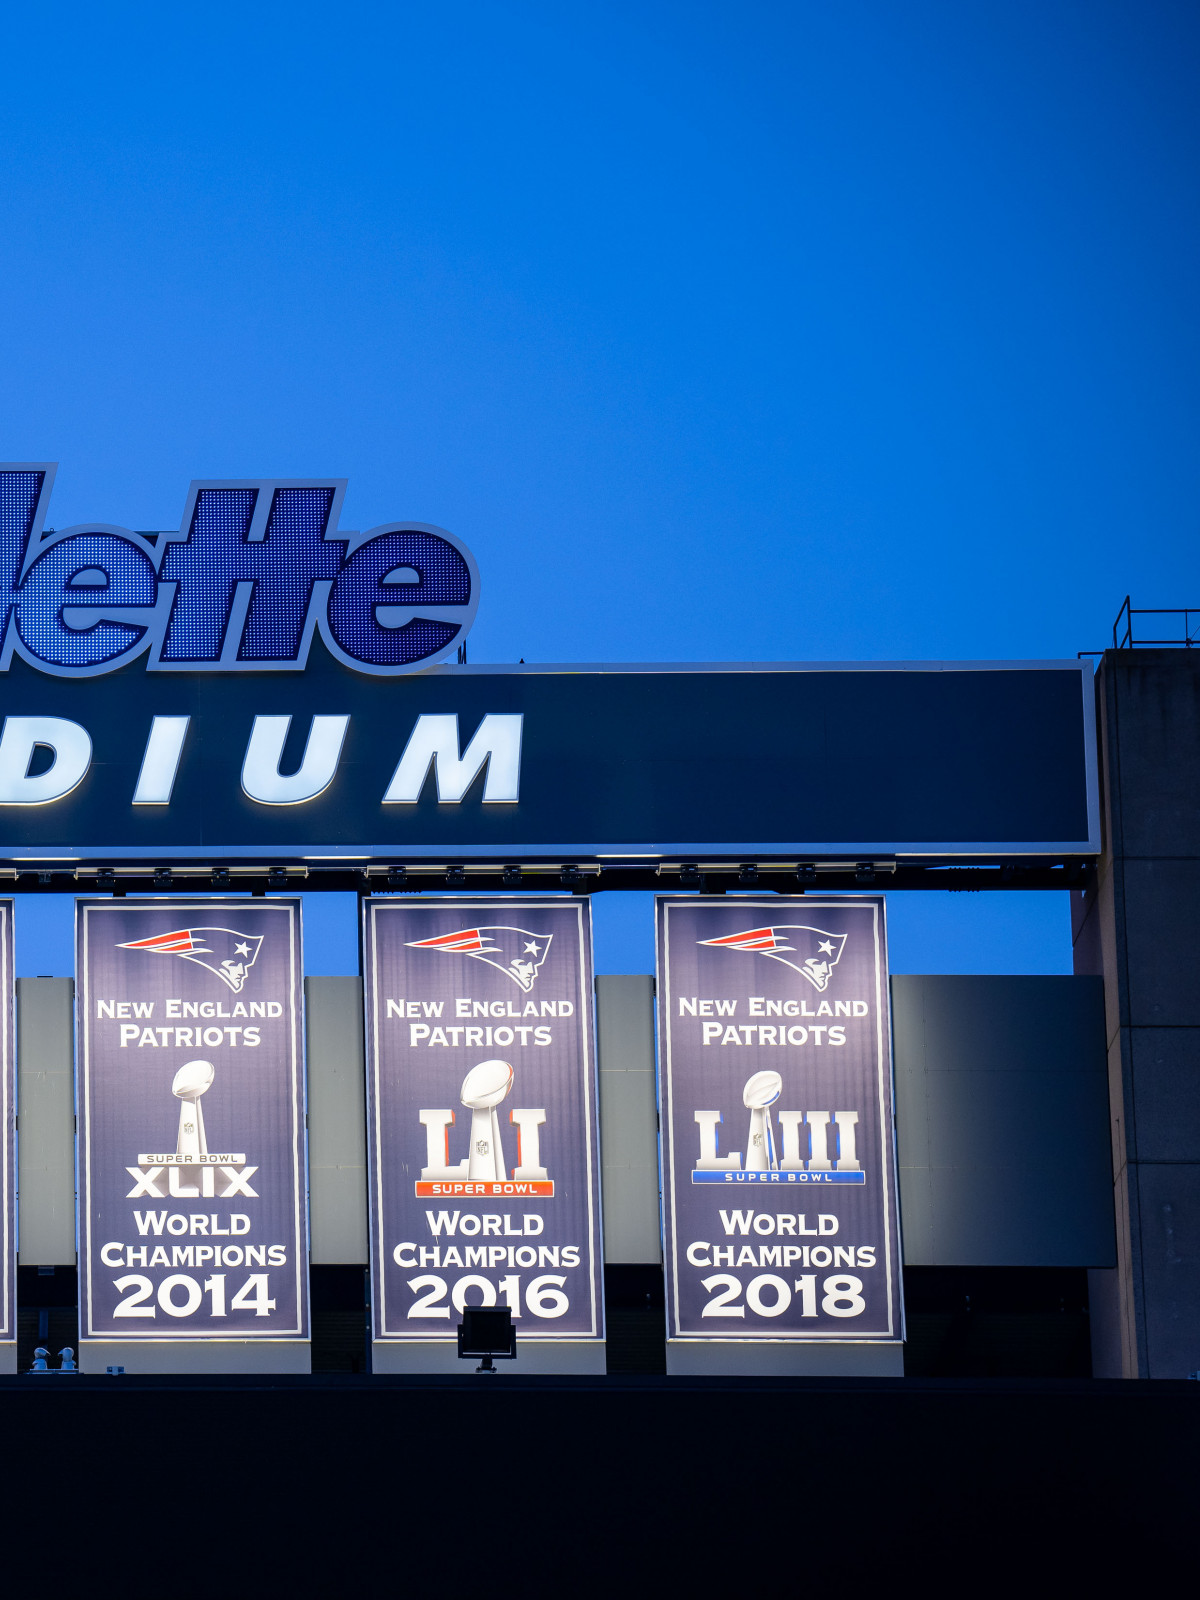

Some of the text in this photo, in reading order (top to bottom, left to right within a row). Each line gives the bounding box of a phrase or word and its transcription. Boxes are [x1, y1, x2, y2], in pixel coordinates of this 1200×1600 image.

[97, 999, 282, 1018] NEW ENGLAND
[387, 998, 573, 1018] NEW ENGLAND
[679, 997, 868, 1017] NEW ENGLAND
[120, 1024, 261, 1047] PATRIOTS
[409, 1024, 552, 1046] PATRIOTS
[702, 1022, 846, 1046] PATRIOTS
[419, 1109, 548, 1181] LI
[694, 1111, 860, 1171] LIII
[125, 1167, 259, 1198] XLIX
[432, 1184, 537, 1194] SUPER BOWL
[725, 1173, 832, 1182] SUPER BOWL
[134, 1211, 250, 1235] WORLD
[426, 1211, 543, 1236] WORLD
[719, 1210, 838, 1236] WORLD
[101, 1242, 286, 1267] CHAMPIONS
[394, 1243, 580, 1267] CHAMPIONS
[687, 1242, 876, 1267] CHAMPIONS
[113, 1274, 275, 1318] 2014
[407, 1275, 569, 1319] 2016
[701, 1274, 865, 1318] 2018
